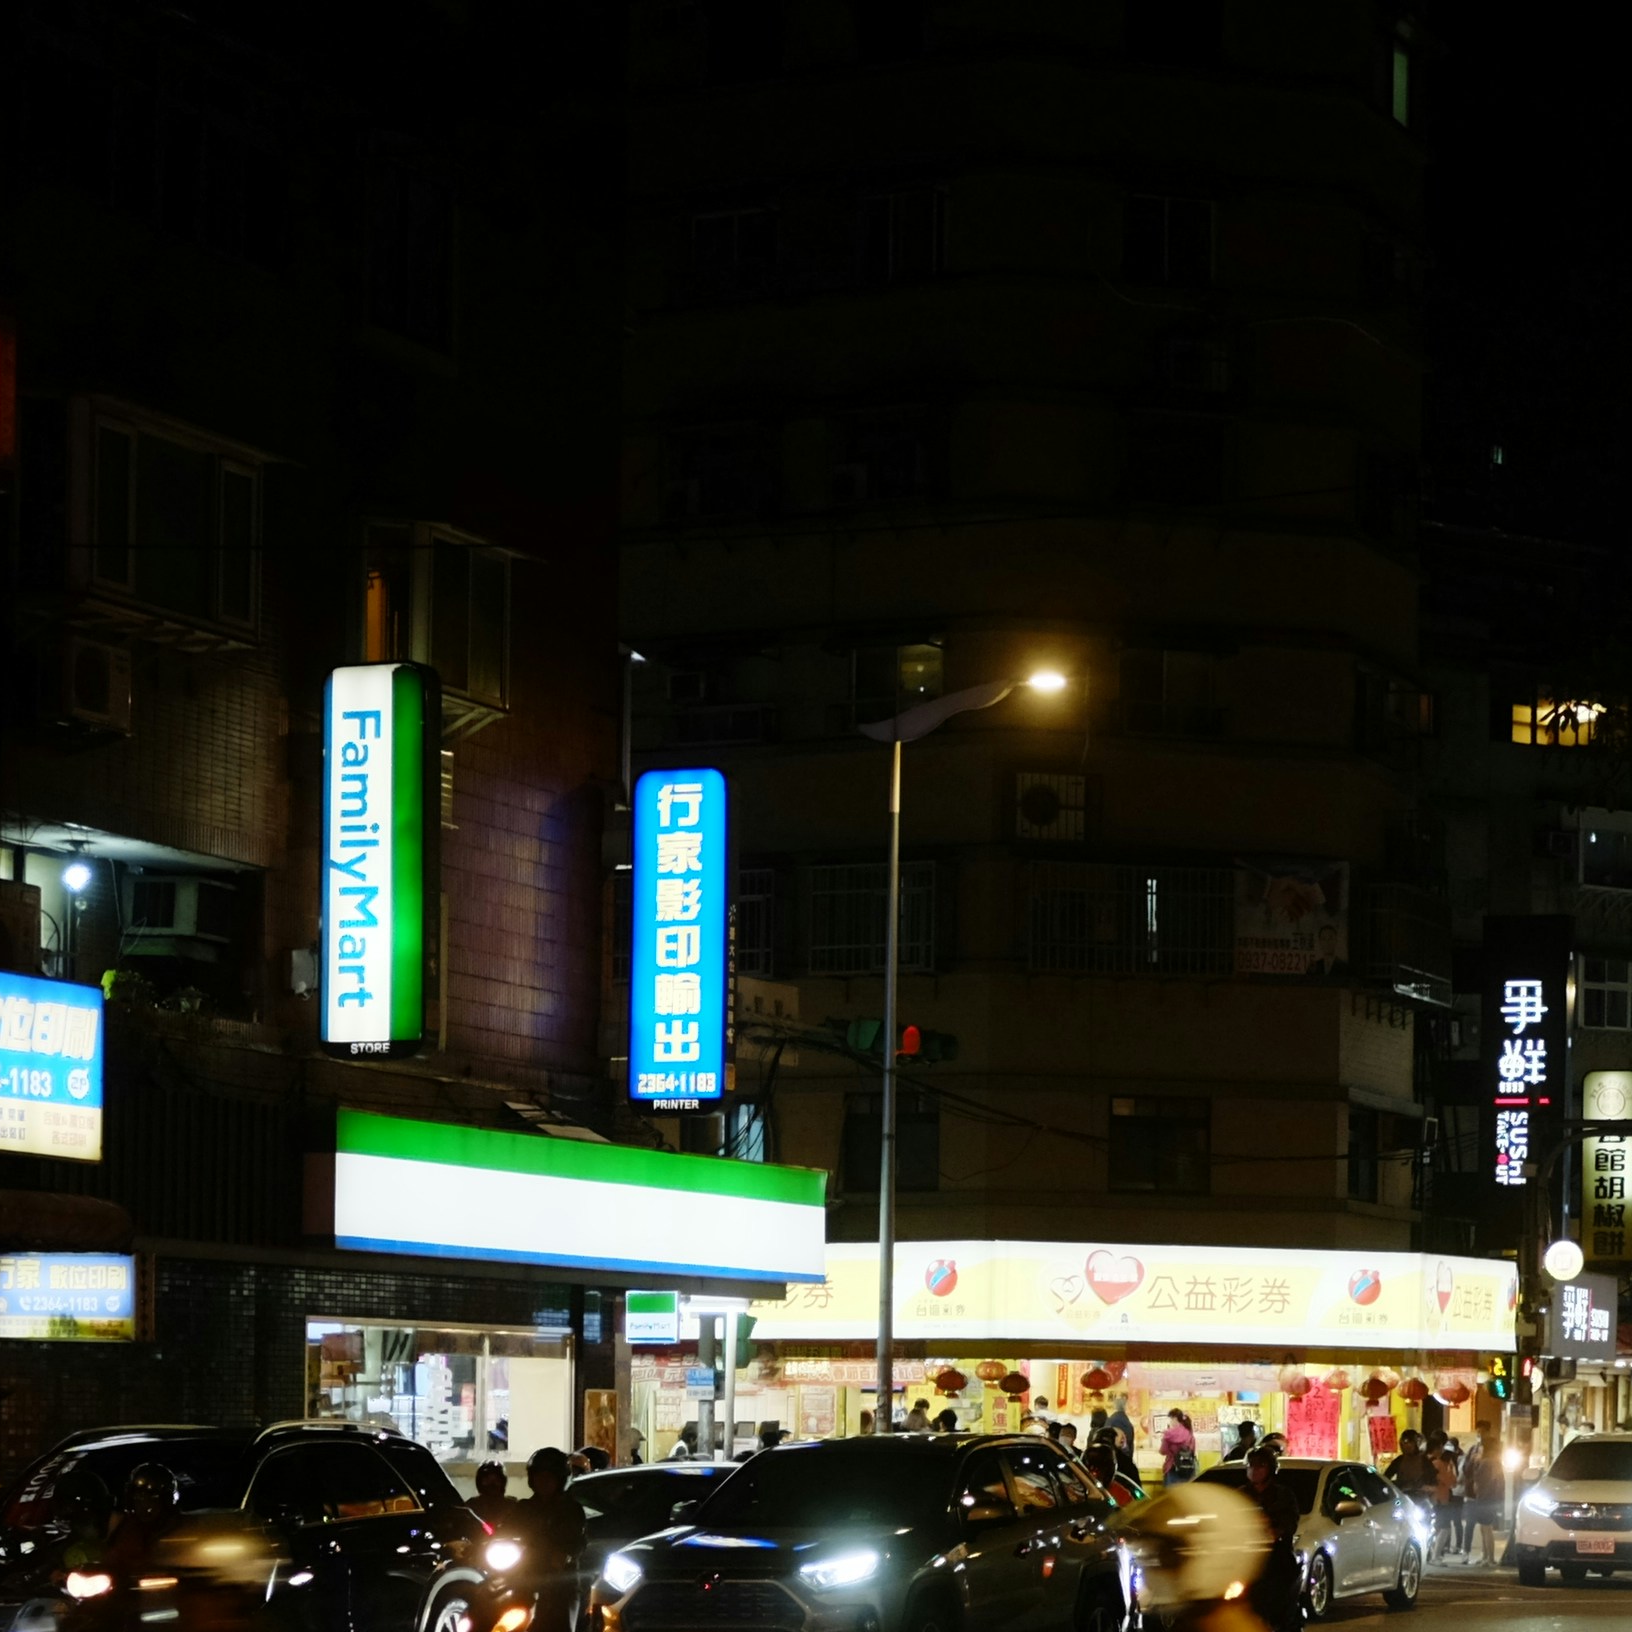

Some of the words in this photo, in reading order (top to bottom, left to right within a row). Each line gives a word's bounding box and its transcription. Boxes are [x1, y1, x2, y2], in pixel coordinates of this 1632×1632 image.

[327, 709, 382, 1009] FamilyMart
[654, 783, 703, 1062] 行家影印輸出
[350, 1041, 391, 1055] STORE
[1498, 980, 1549, 1093] 爭鮮
[654, 1098, 700, 1110] PRINTER
[49, 1265, 128, 1290] 數位印刷
[33, 1296, 98, 1313] 2364-1183
[1146, 1274, 1291, 1315] 公益彩券
